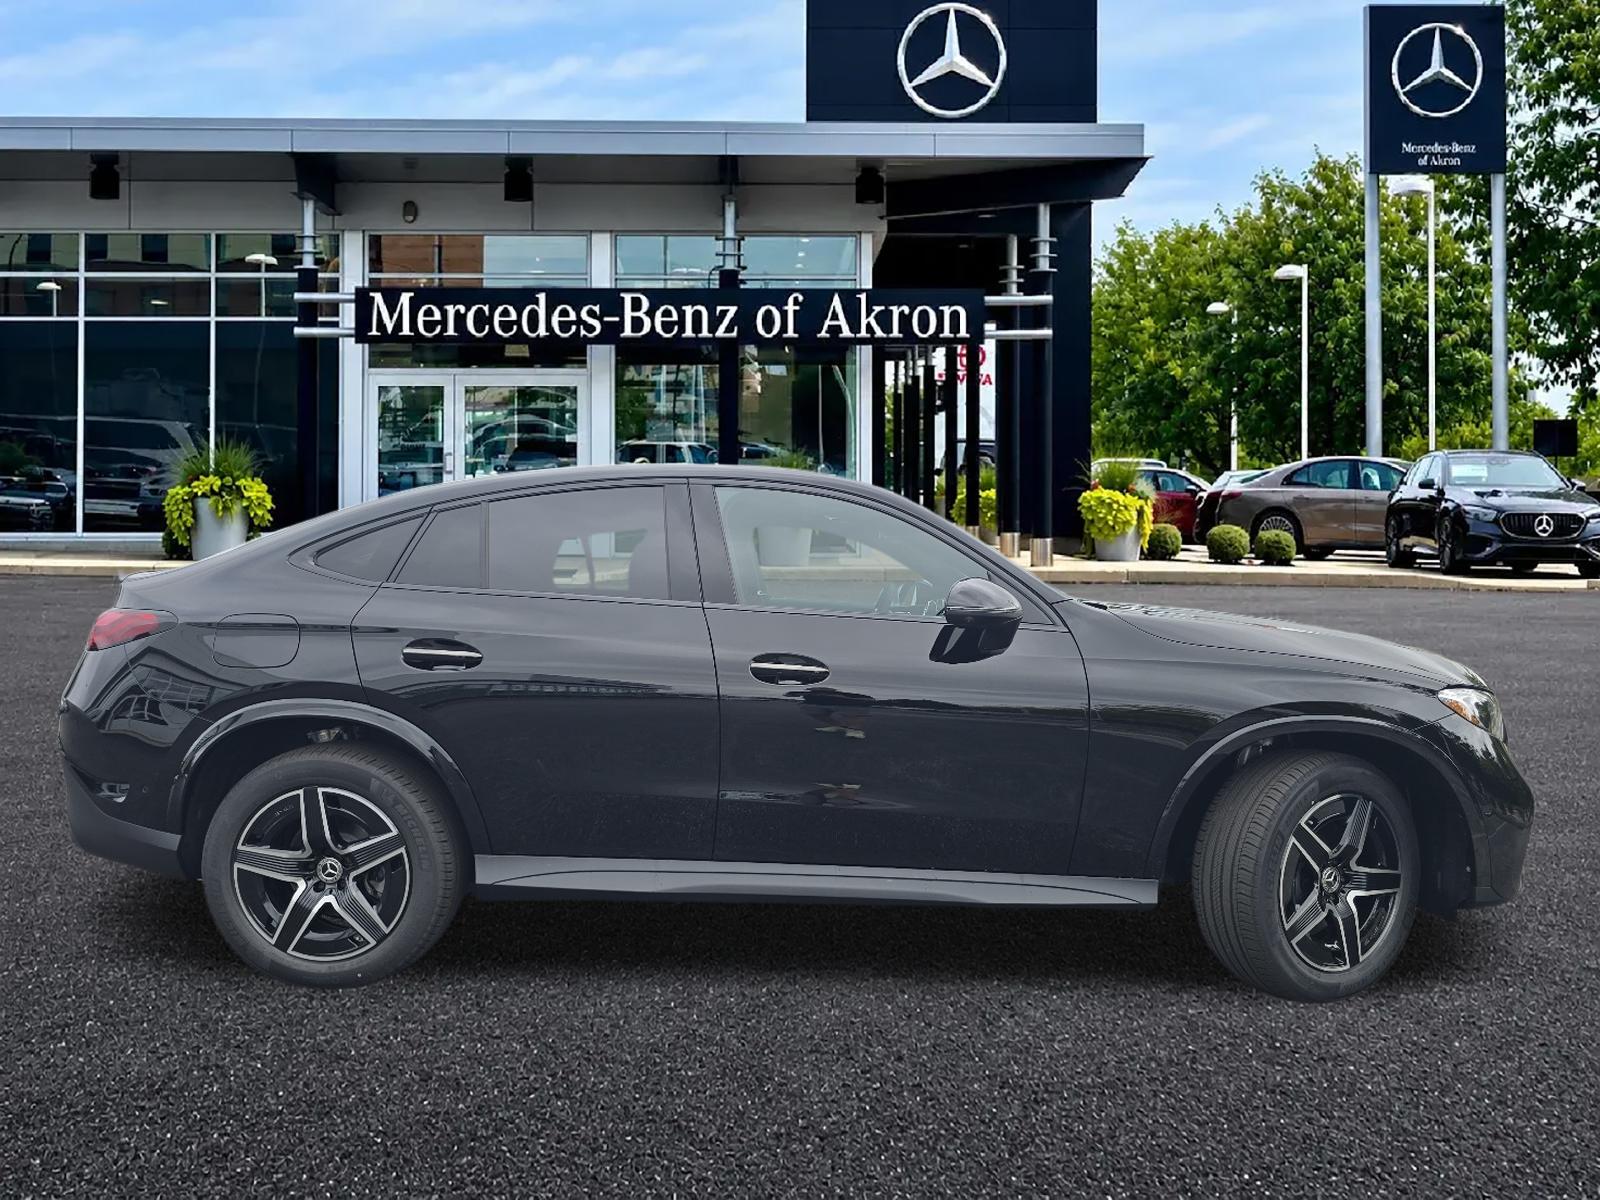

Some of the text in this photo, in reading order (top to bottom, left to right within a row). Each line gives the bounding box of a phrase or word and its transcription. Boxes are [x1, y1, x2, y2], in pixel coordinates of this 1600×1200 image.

[1401, 141, 1476, 153] Mercedes-Benz
[1417, 154, 1461, 166] of Akron
[367, 291, 970, 338] Mercedes-Benz of Akron
